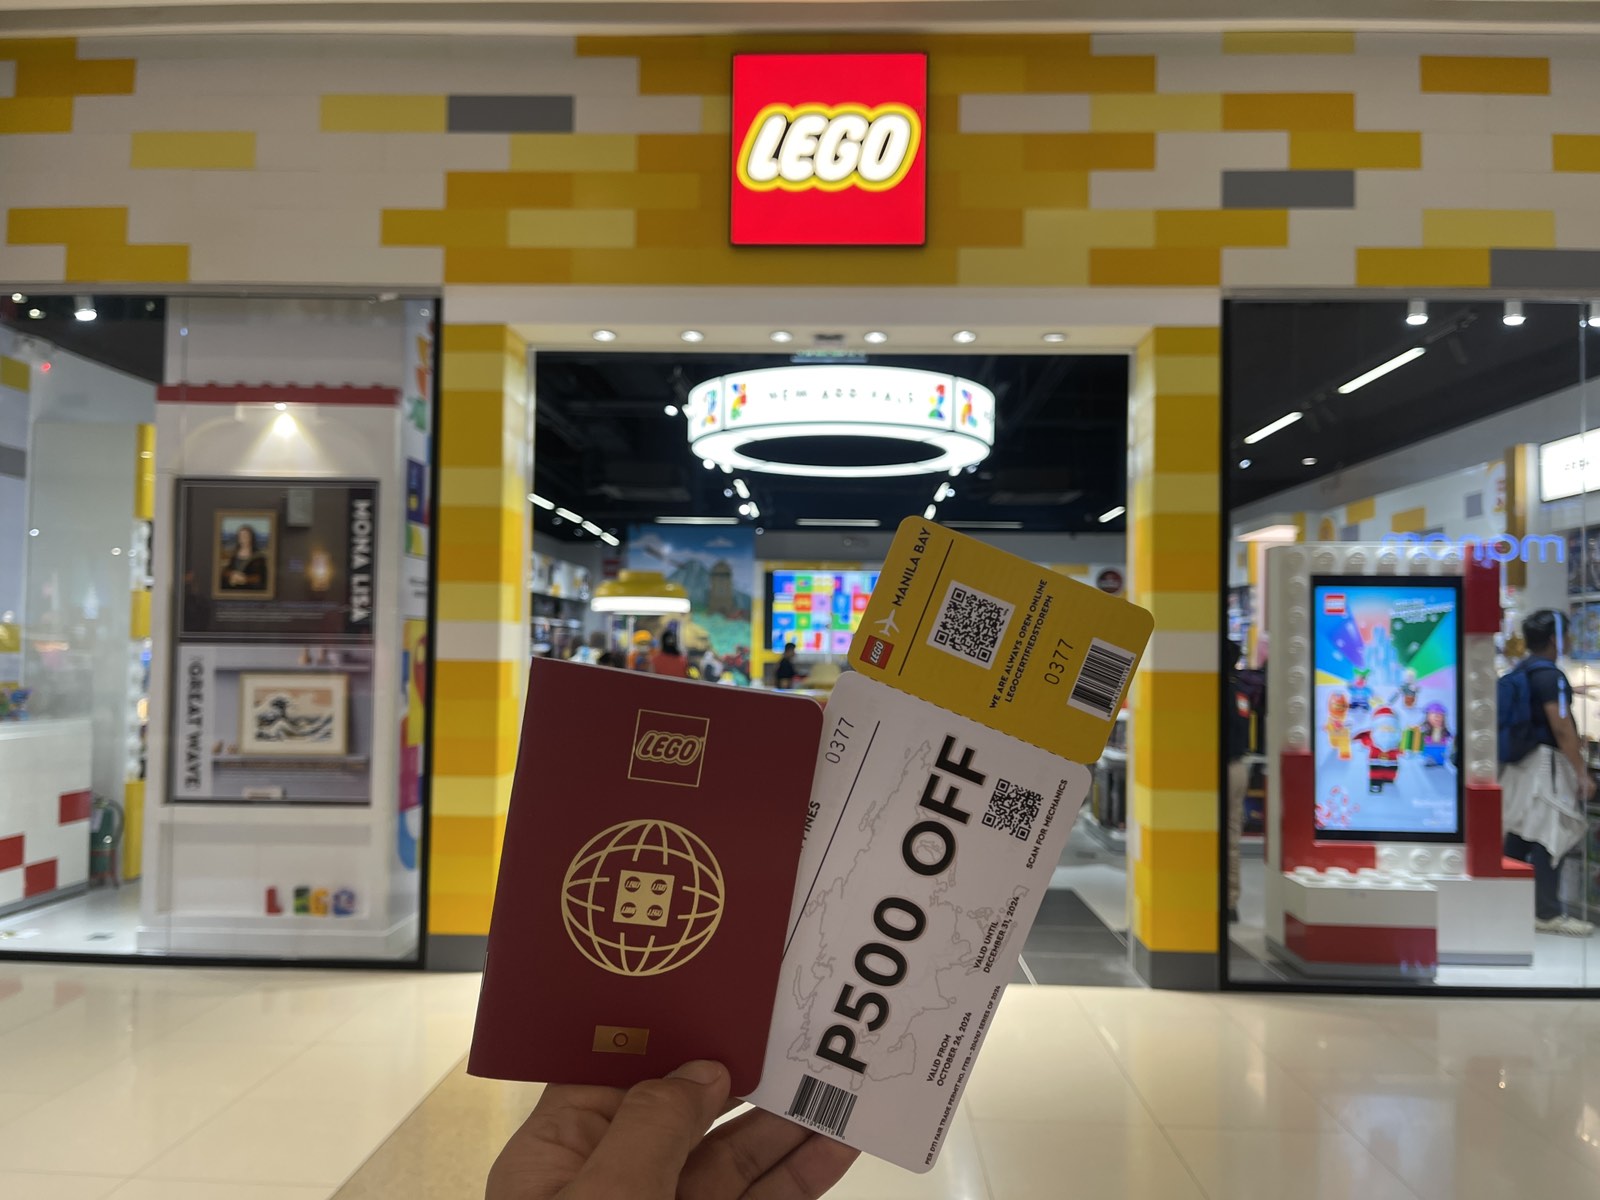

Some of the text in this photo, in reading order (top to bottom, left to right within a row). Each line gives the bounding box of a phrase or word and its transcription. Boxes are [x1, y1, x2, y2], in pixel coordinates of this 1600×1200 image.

[747, 114, 911, 181] LEGO
[352, 498, 371, 568] MONA
[892, 527, 930, 606] MANILA BAY
[870, 640, 885, 663] LEGO
[989, 579, 1047, 708] WE ARE ALWAYS OPEN ONLINE
[1005, 595, 1053, 703] LEGOCERTIFIEDSTOREPH
[1044, 638, 1073, 685] 0377
[640, 734, 698, 761] LEGO
[825, 717, 854, 764] 0377
[902, 735, 986, 875] OFF
[1026, 779, 1068, 869] SCAN FOR MECHANICS
[973, 922, 999, 968] VALID UNTIL
[983, 897, 1019, 973] DECEMBER 31, 2024
[816, 897, 926, 1074] P500
[926, 1034, 951, 1081] VALID FROM
[937, 1012, 972, 1086] OCTOBER 26, 2024
